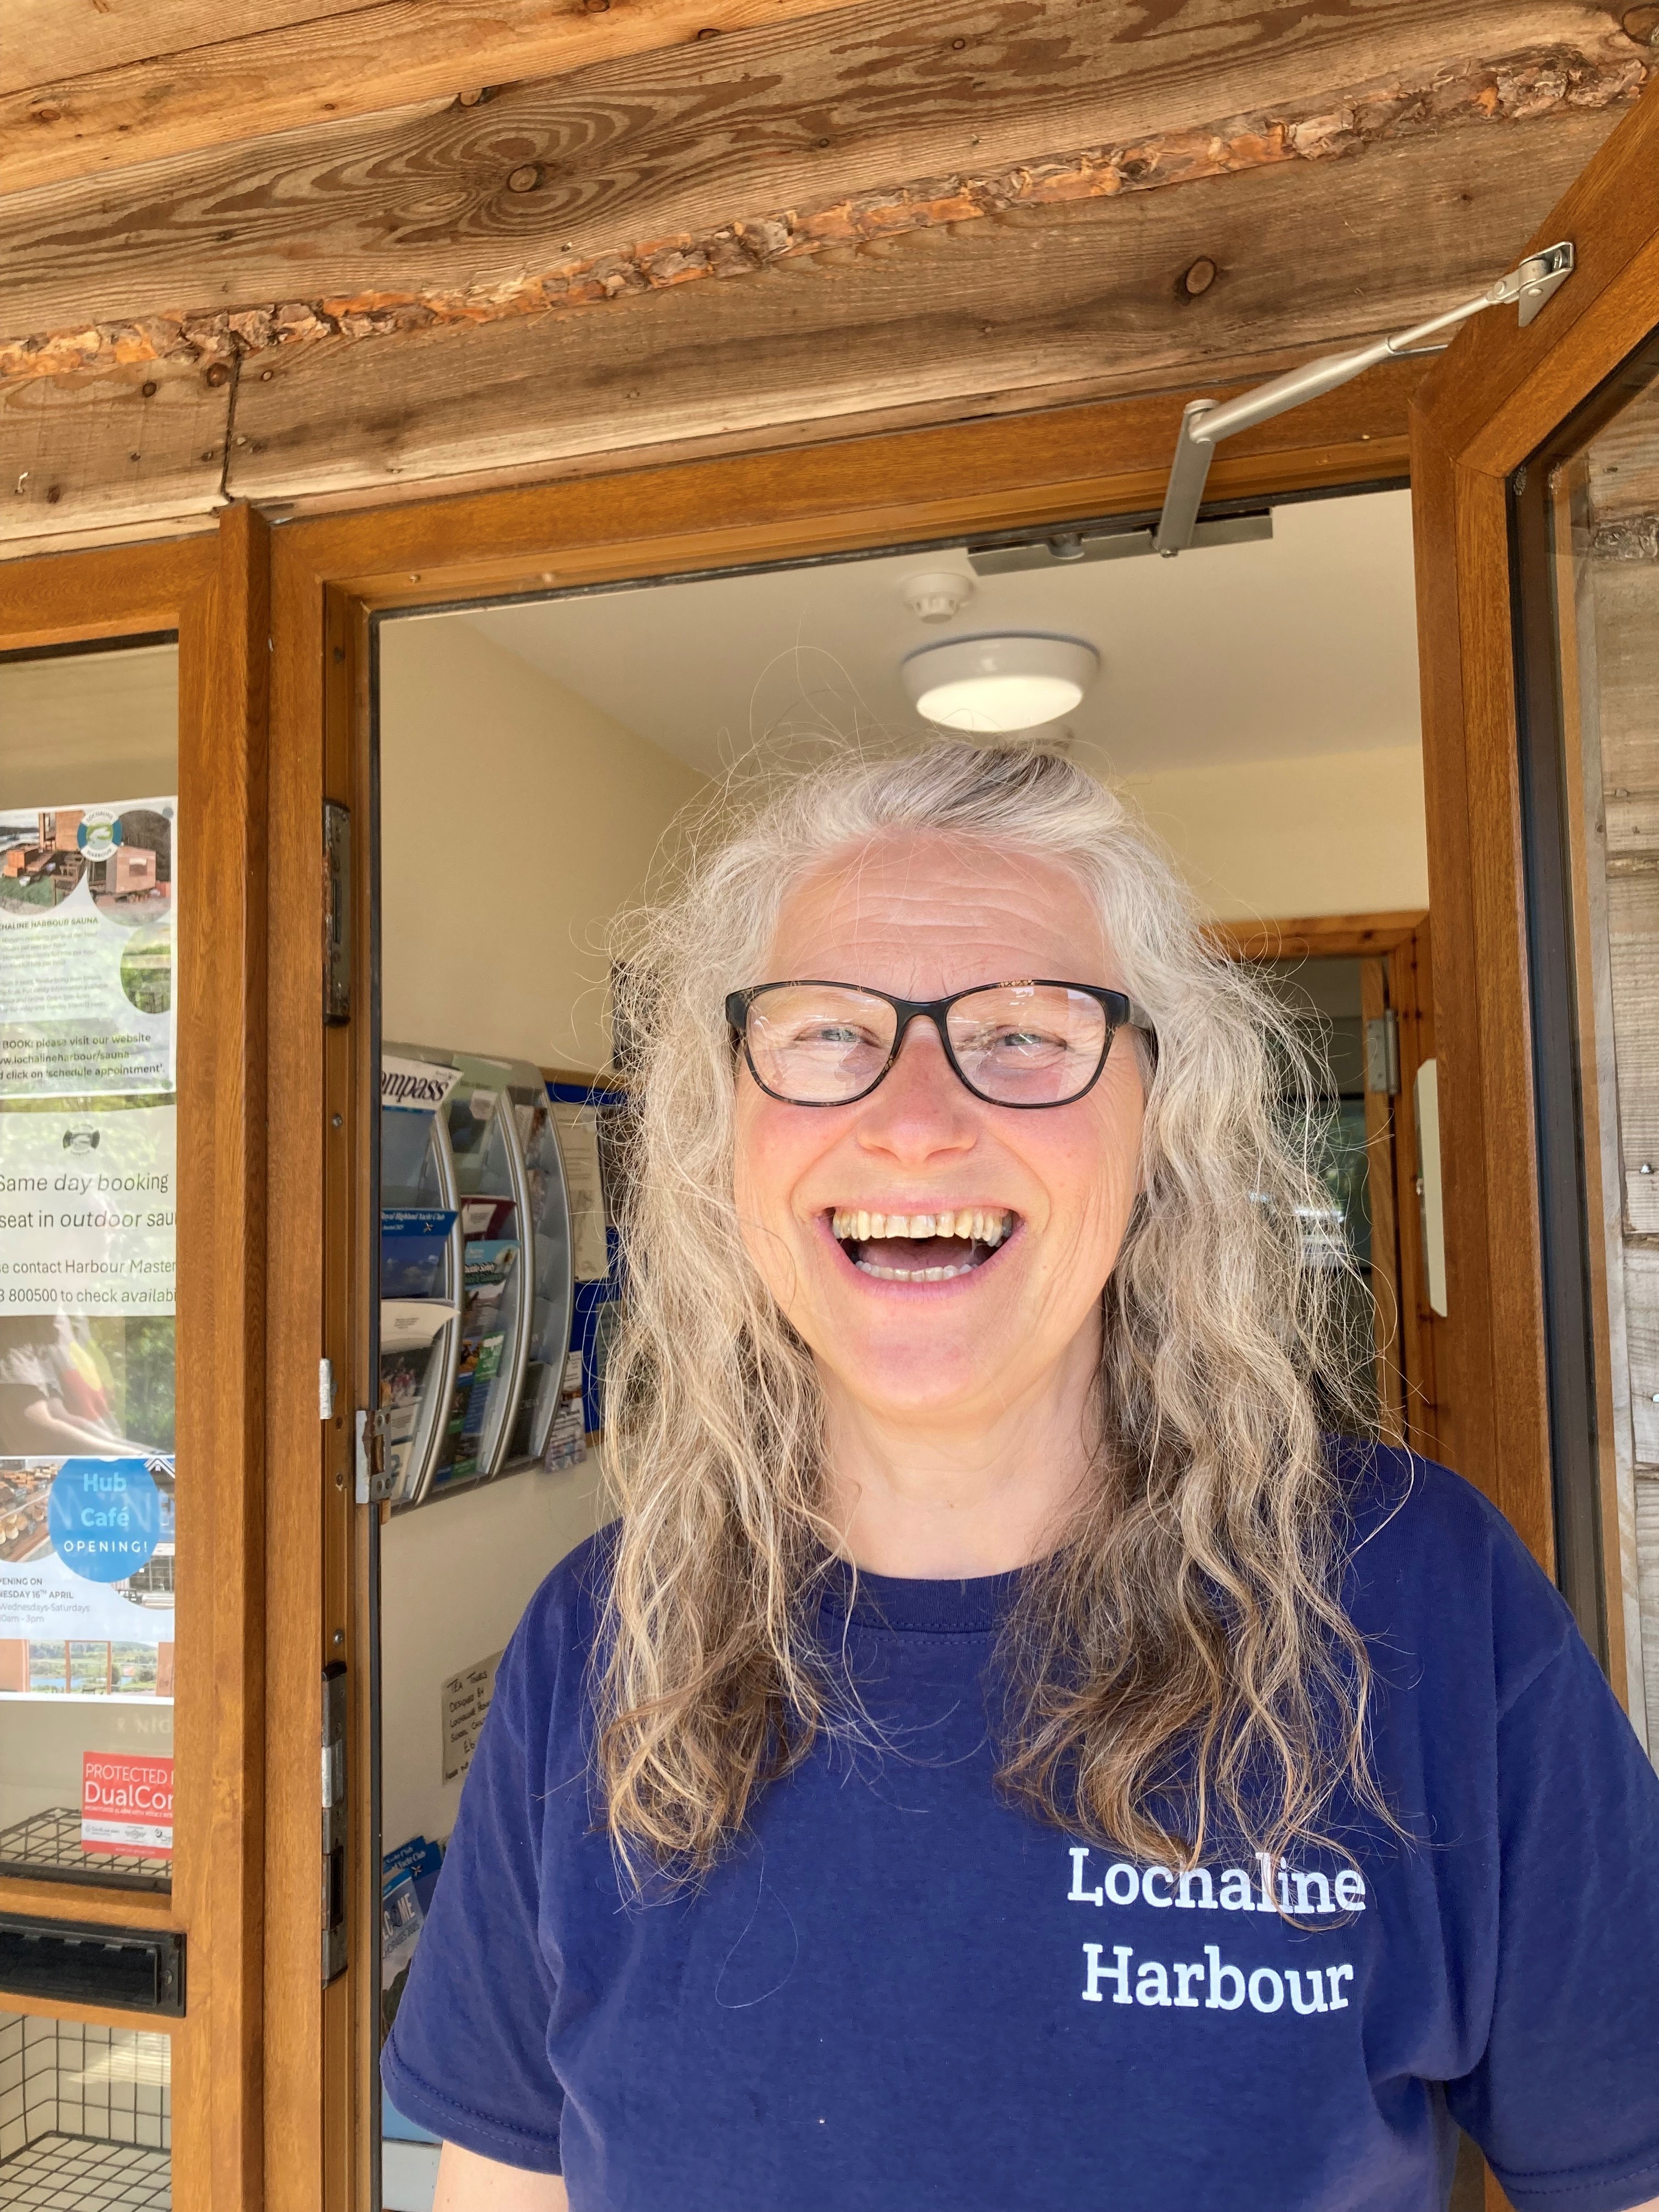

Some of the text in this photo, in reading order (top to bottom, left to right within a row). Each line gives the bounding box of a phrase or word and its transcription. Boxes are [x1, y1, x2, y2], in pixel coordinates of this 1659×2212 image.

[36, 1038, 67, 1050] please
[70, 1035, 90, 1046] visit
[92, 1037, 109, 1045] our
[111, 1032, 151, 1043] website
[6, 1070, 27, 1080] click
[0, 1172, 169, 1196] Same day booking
[0, 1210, 176, 1229] seat in outdoor sau
[13, 1260, 62, 1274] contact
[65, 1260, 126, 1273] Harbour
[9, 1288, 58, 1302] 800500
[61, 1290, 73, 1302] to
[77, 1288, 117, 1303] check
[83, 1472, 127, 1492] Hub
[81, 1506, 130, 1527] Café
[64, 1540, 148, 1554] OPENING!
[49, 1591, 74, 1599] APRIL
[85, 1763, 168, 1785] PROTECTED
[1082, 1943, 1354, 2016] Harbour
